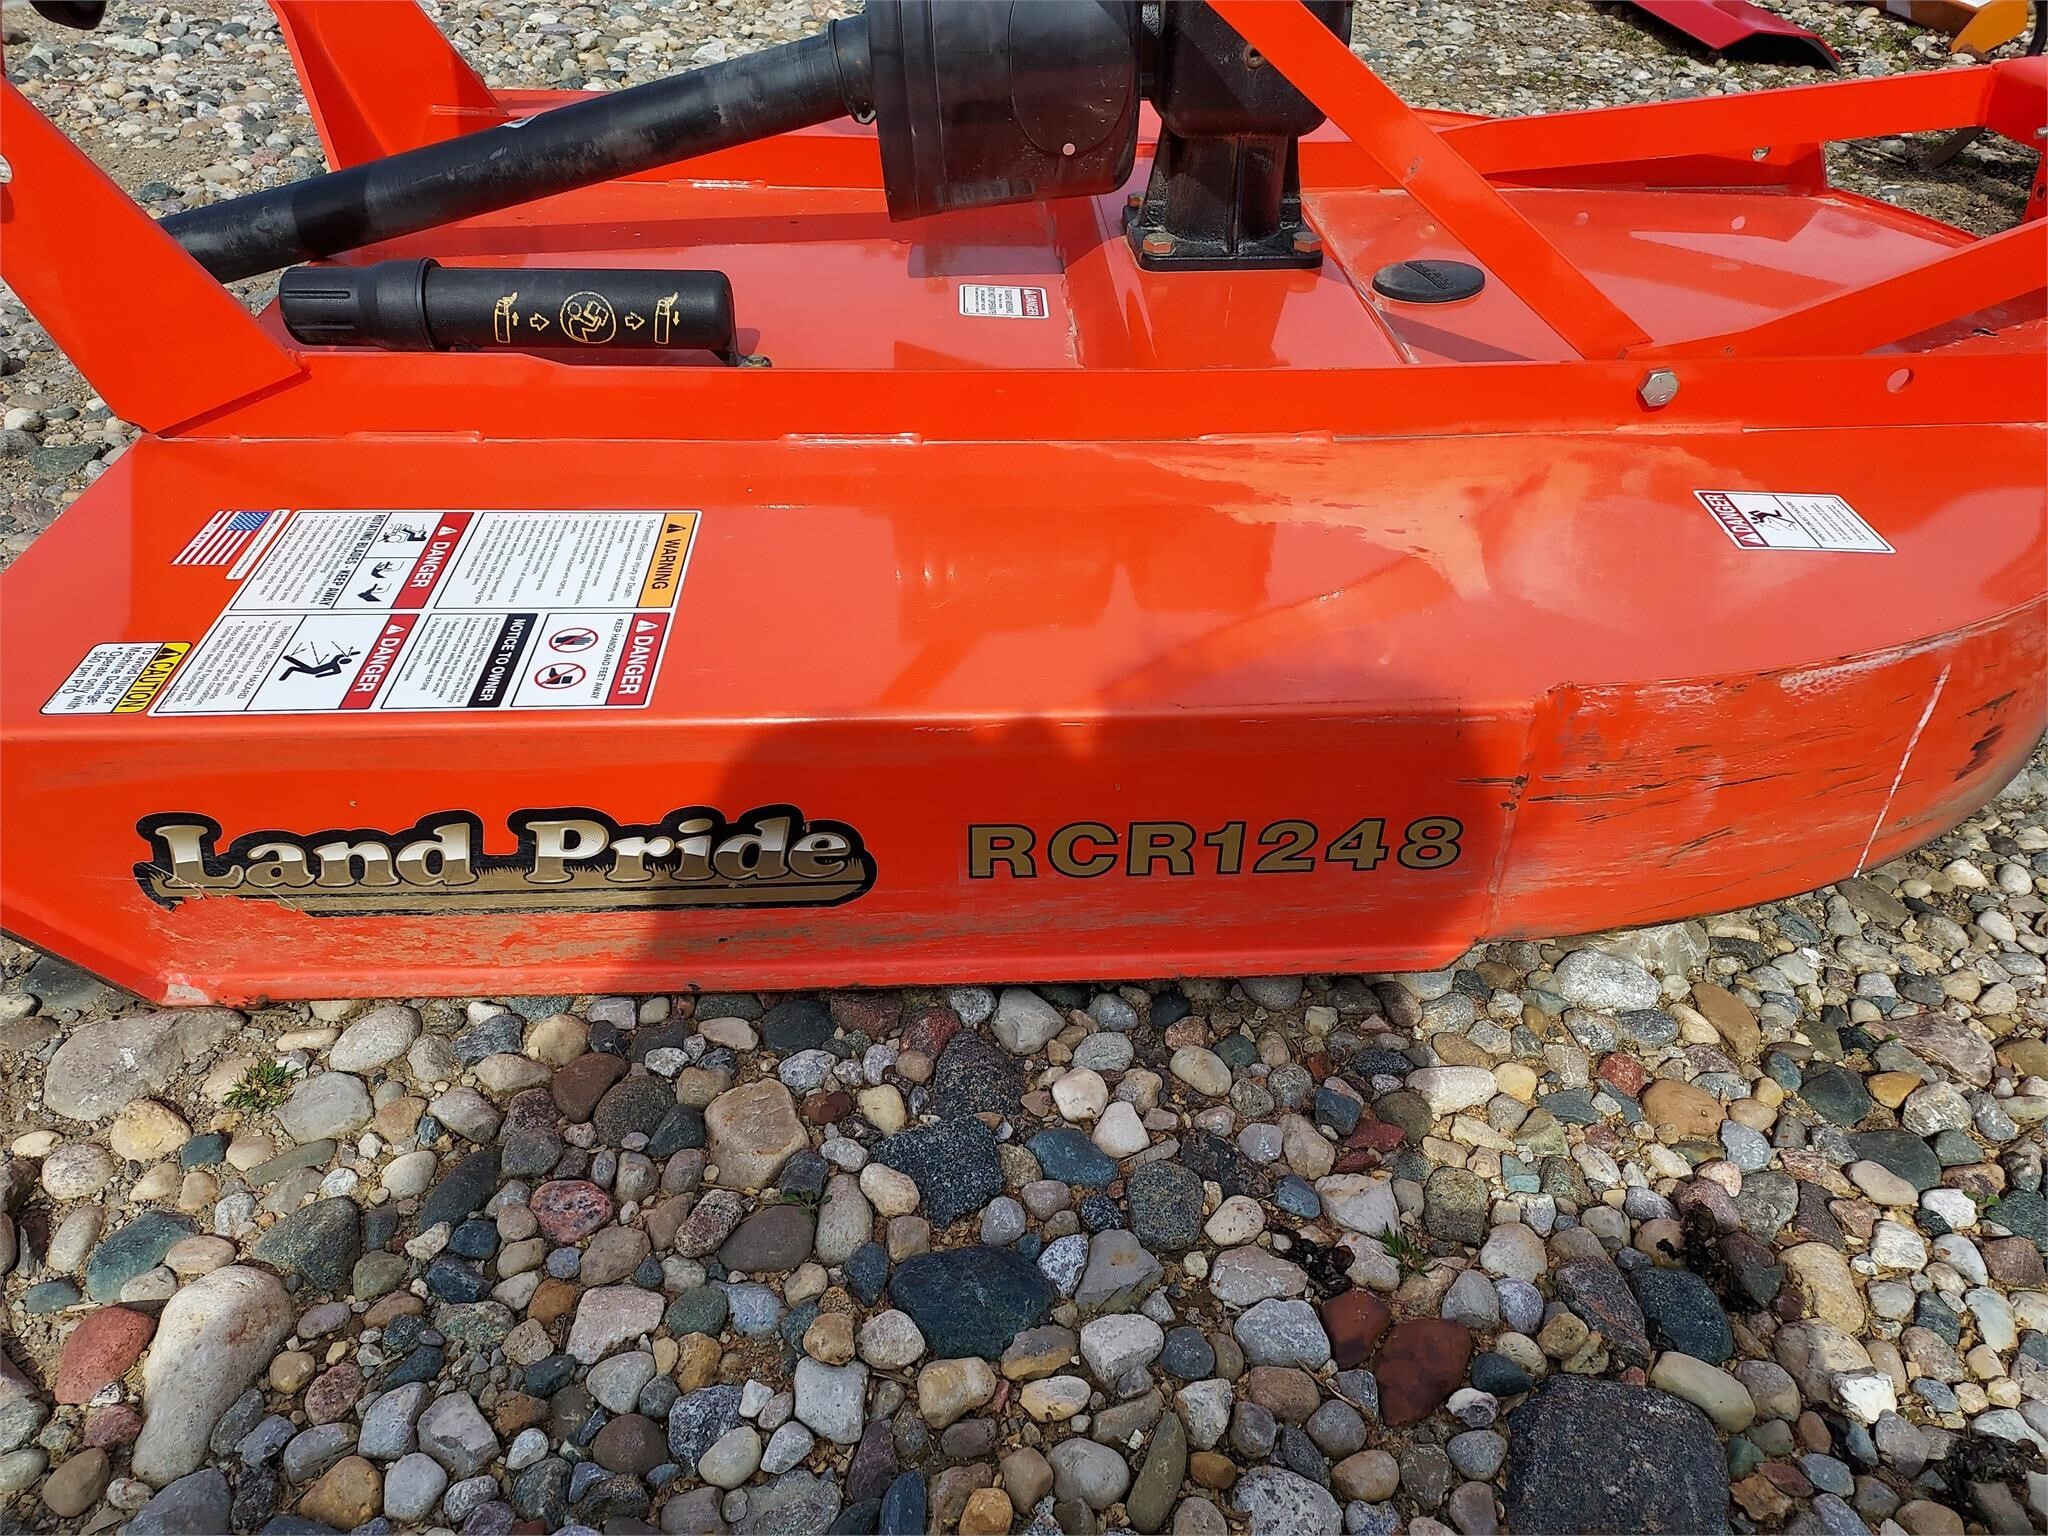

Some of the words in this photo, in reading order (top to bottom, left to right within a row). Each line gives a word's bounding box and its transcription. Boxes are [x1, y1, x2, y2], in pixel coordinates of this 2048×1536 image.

[1025, 294, 1039, 315] DANGER
[1703, 494, 1754, 532] DANGER
[358, 514, 386, 540] ROTATING
[343, 542, 369, 564] BLADES
[409, 541, 451, 587] DANGER
[650, 539, 681, 589] WARNING
[330, 570, 351, 585] KEEP
[317, 587, 341, 605] AWAY
[500, 619, 526, 650] NOTICE
[612, 618, 624, 632] KEEP
[268, 625, 292, 649] THROWN
[605, 633, 619, 652] HANDS
[86, 651, 107, 662] 540
[110, 646, 142, 673] Machine
[140, 646, 159, 654] To
[494, 652, 512, 664] TO
[601, 653, 613, 665] AND
[73, 664, 94, 677] rpm
[90, 651, 123, 676] Operate
[125, 656, 150, 674] avoid
[252, 650, 275, 672] OBJECT
[352, 637, 401, 692] DANGER
[617, 635, 654, 694] DANGER
[477, 666, 506, 700] OWNER
[596, 667, 608, 680] FEET
[60, 679, 84, 693] PTO
[75, 678, 101, 692] only
[81, 676, 119, 705] Damage:
[106, 676, 136, 695] Injury
[118, 662, 175, 707] CAUTION
[235, 674, 260, 698] HAZARD
[590, 682, 604, 698] AWAY
[64, 695, 87, 709] with
[102, 696, 117, 704] or
[155, 822, 475, 889] Land
[526, 816, 852, 885] Pride
[967, 815, 1464, 879] RCR1248
